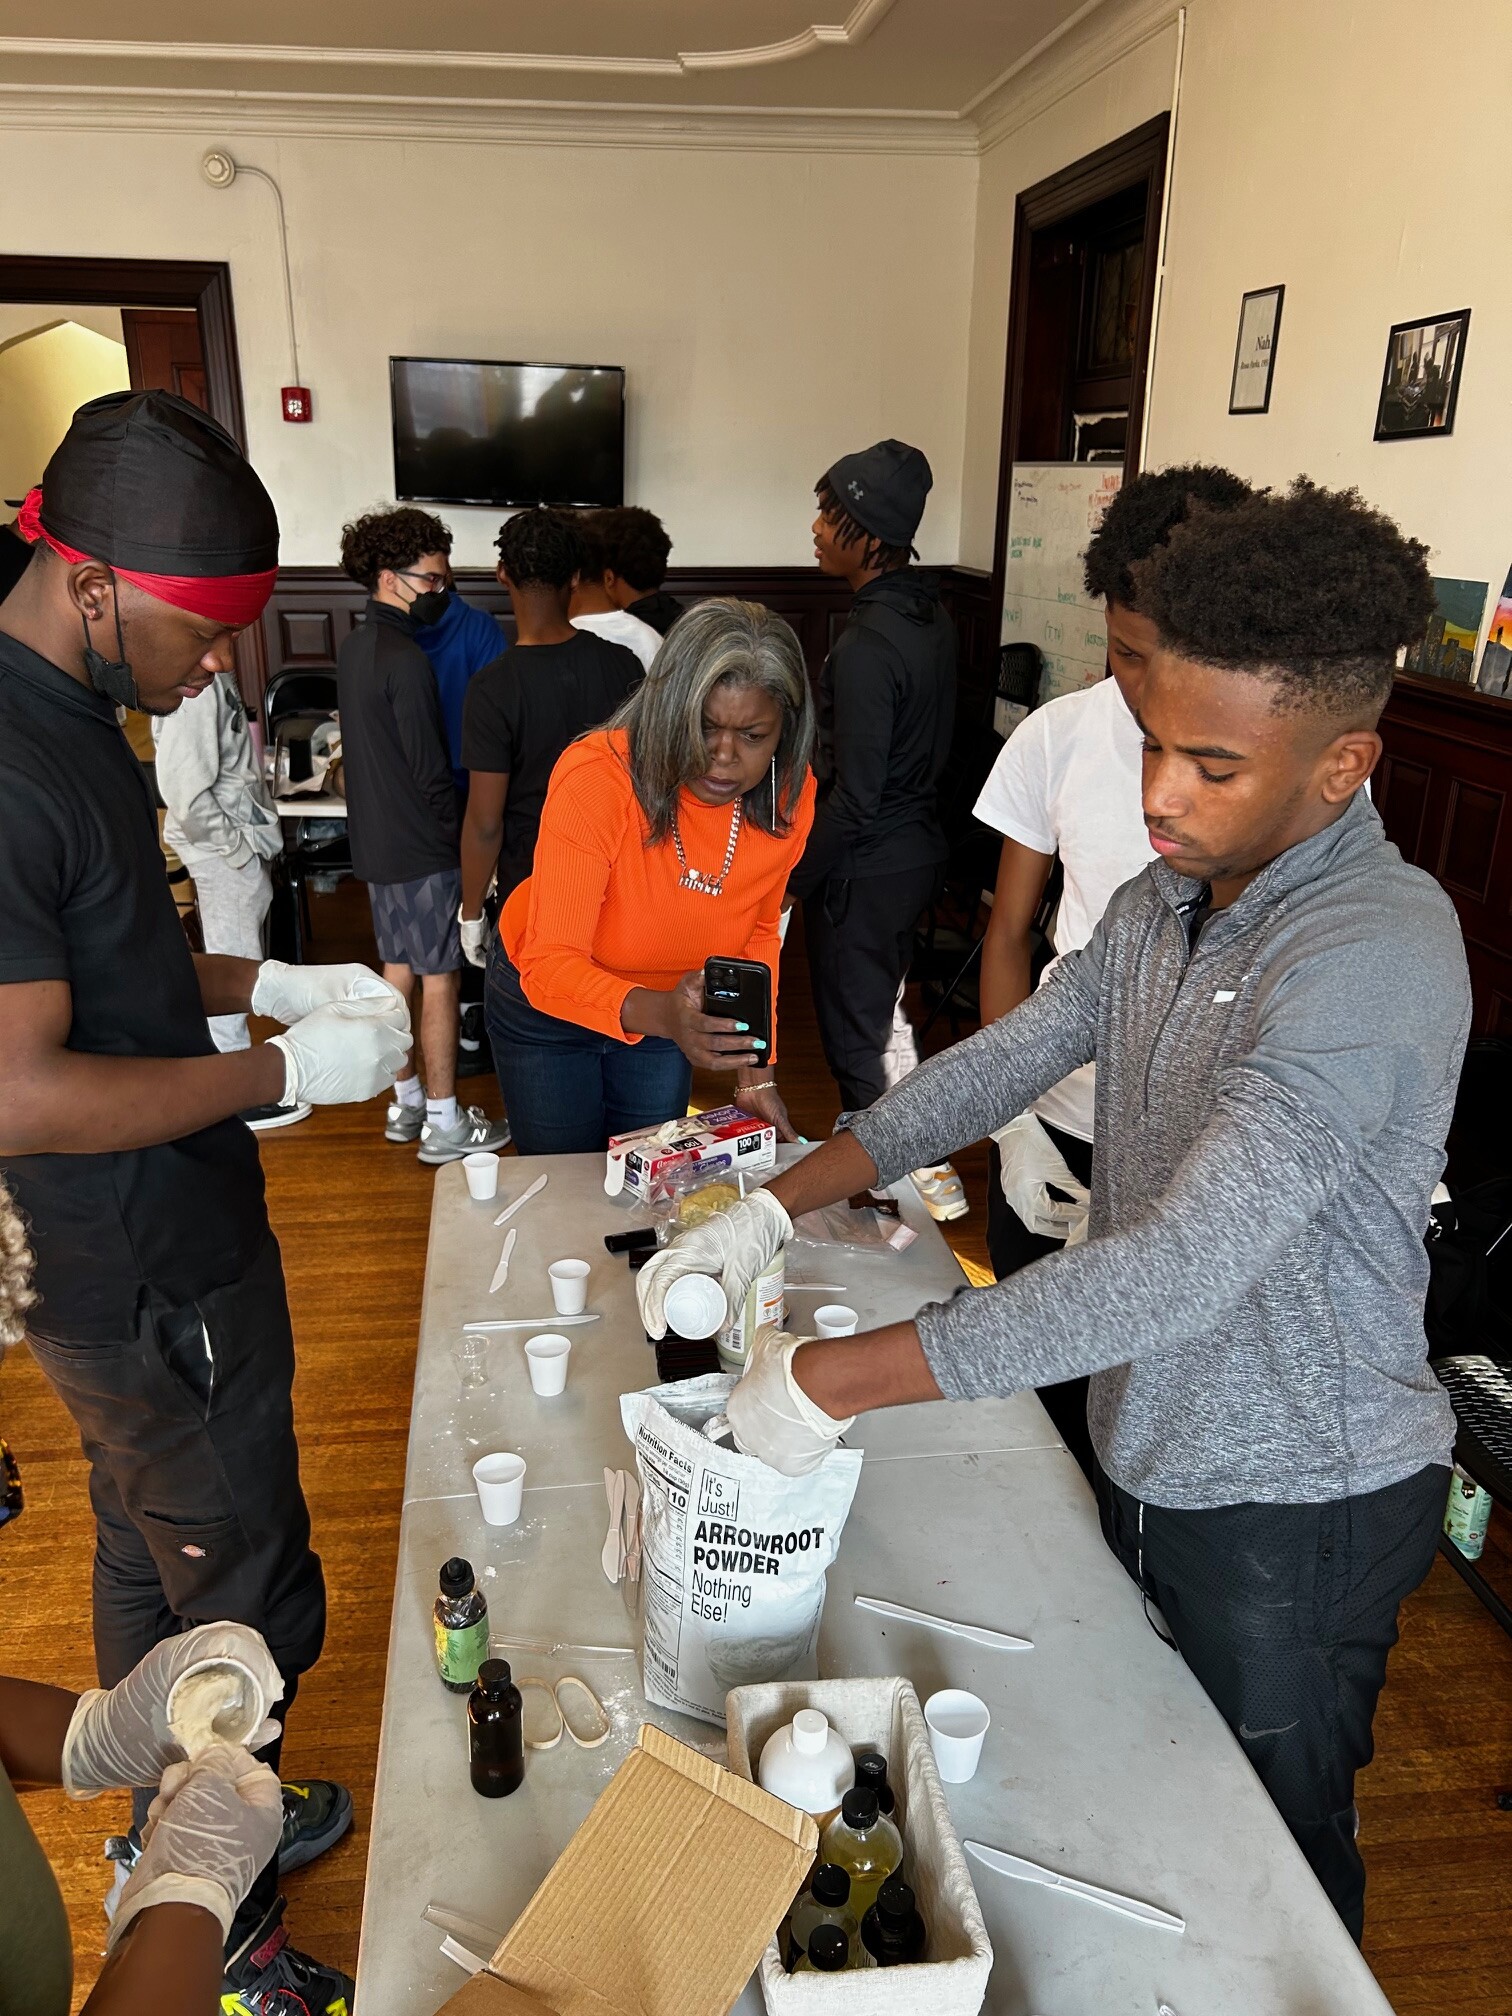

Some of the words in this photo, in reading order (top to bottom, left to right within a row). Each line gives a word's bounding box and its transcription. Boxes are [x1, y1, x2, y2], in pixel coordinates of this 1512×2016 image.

[1256, 334, 1270, 351] Nah
[470, 1128, 487, 1143] N
[684, 1140, 700, 1148] 100
[739, 1137, 752, 1148] 100
[639, 1426, 667, 1457] Nutrition
[669, 1452, 692, 1473] Facts
[705, 1473, 723, 1497] It's
[701, 1496, 735, 1517] Just!
[694, 1520, 825, 1555] ARROWROOT
[693, 1546, 780, 1576] POWDER
[692, 1569, 752, 1608] Nothing
[691, 1593, 728, 1624] Else!
